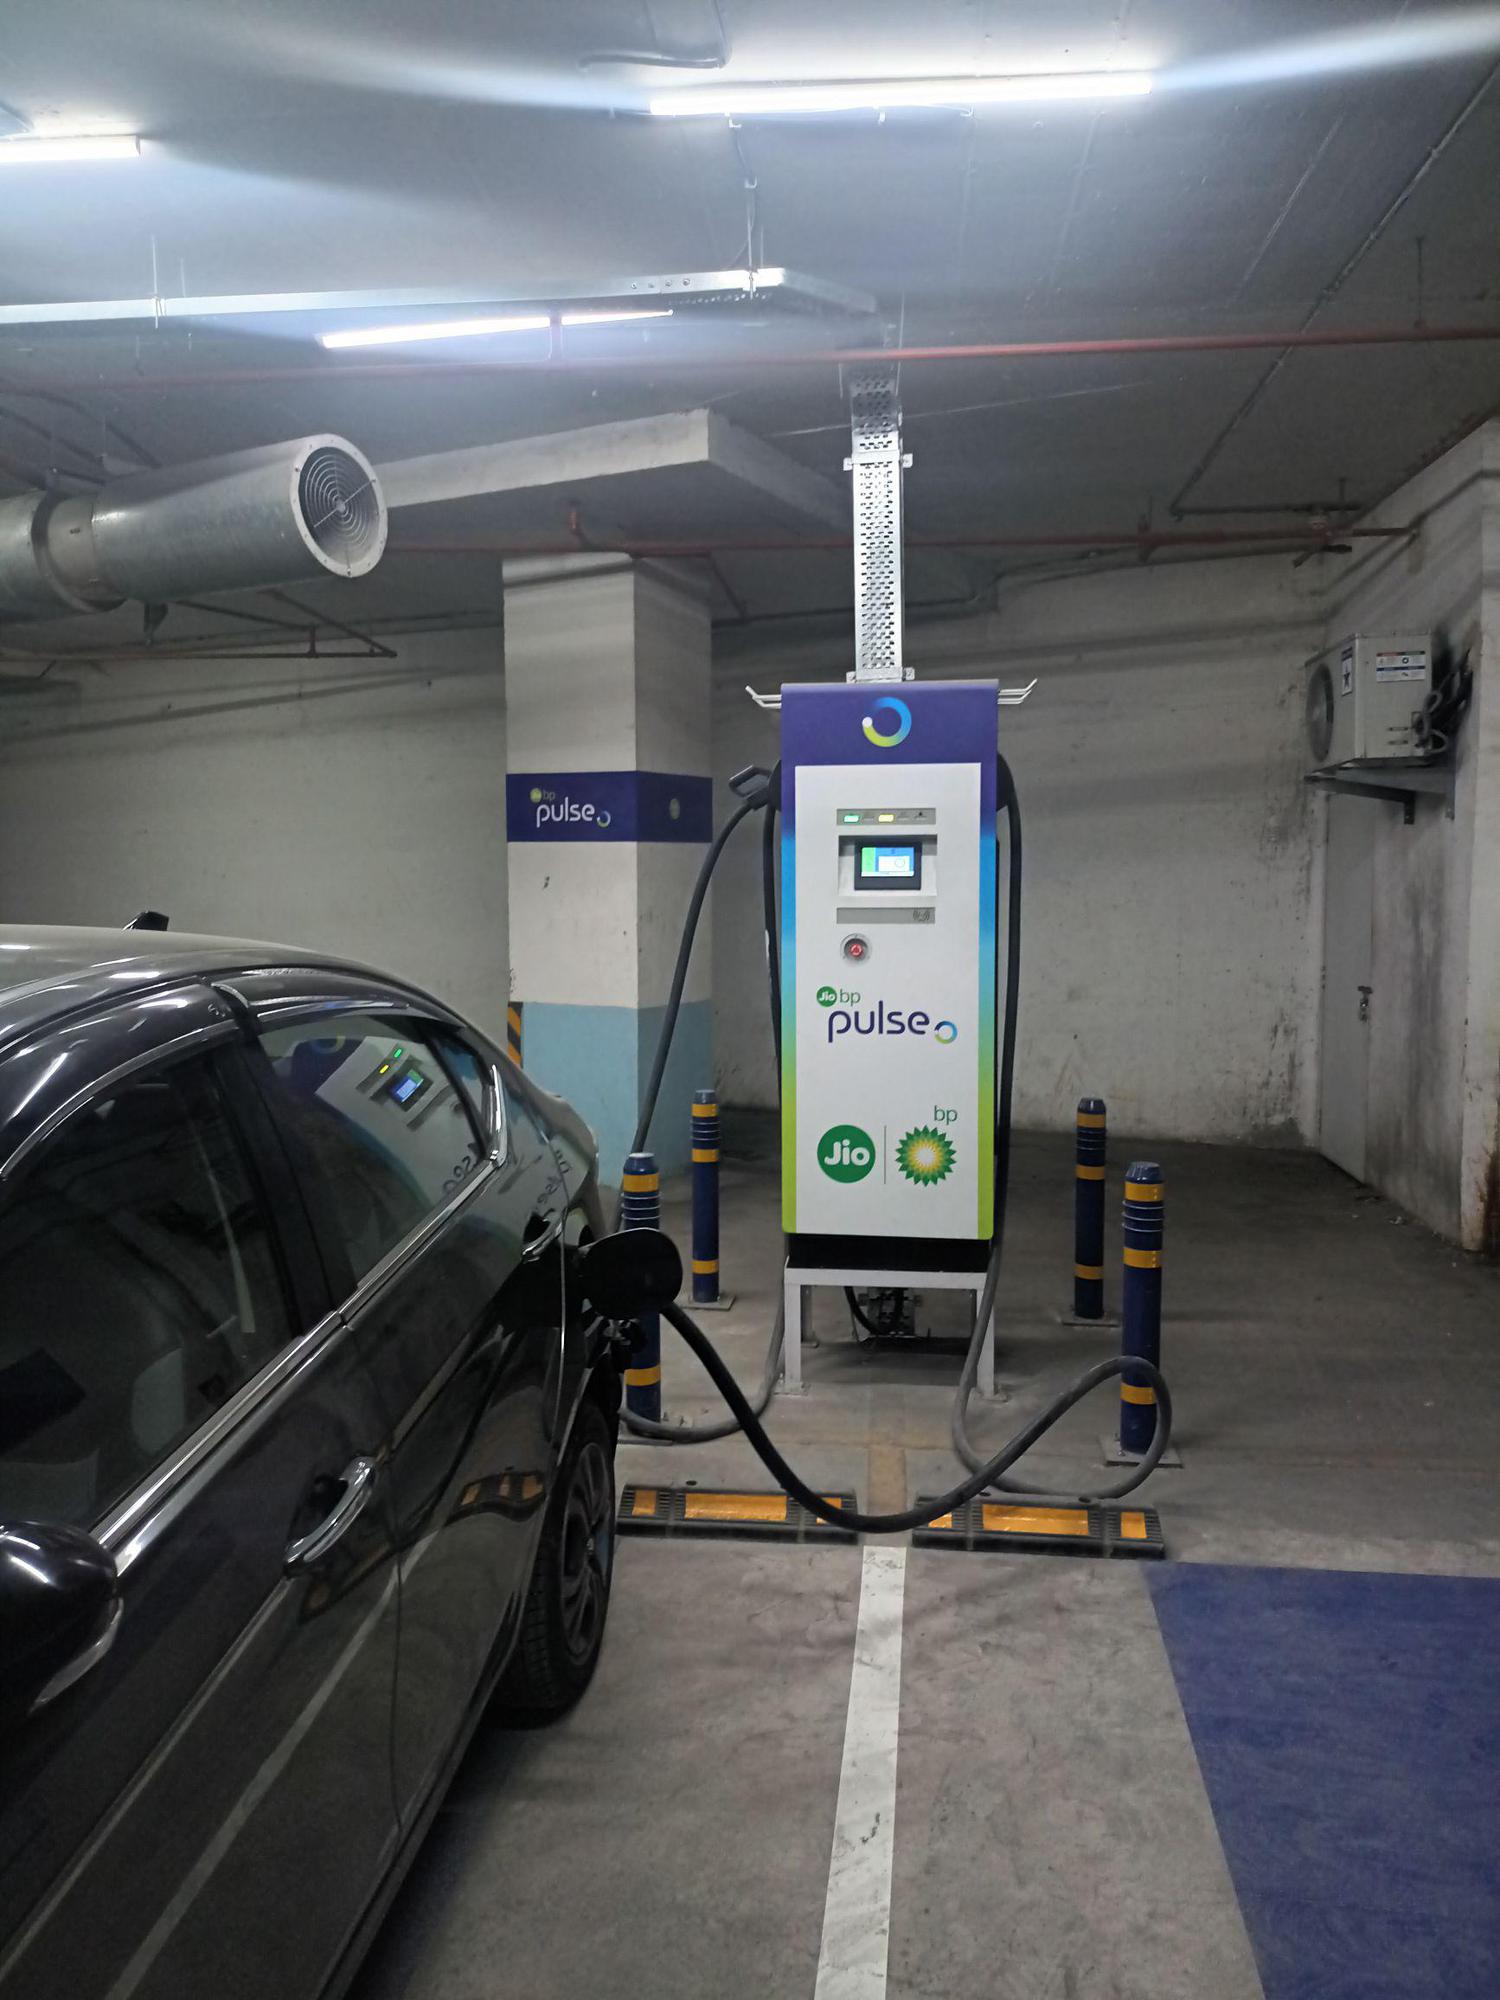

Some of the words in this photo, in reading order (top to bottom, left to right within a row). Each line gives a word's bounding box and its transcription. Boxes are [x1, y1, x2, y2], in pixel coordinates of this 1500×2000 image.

[536, 797, 595, 828] pulse
[840, 989, 861, 1007] bp
[828, 1000, 930, 1043] pulse
[934, 1105, 959, 1125] bp
[824, 1139, 871, 1167] Jio
